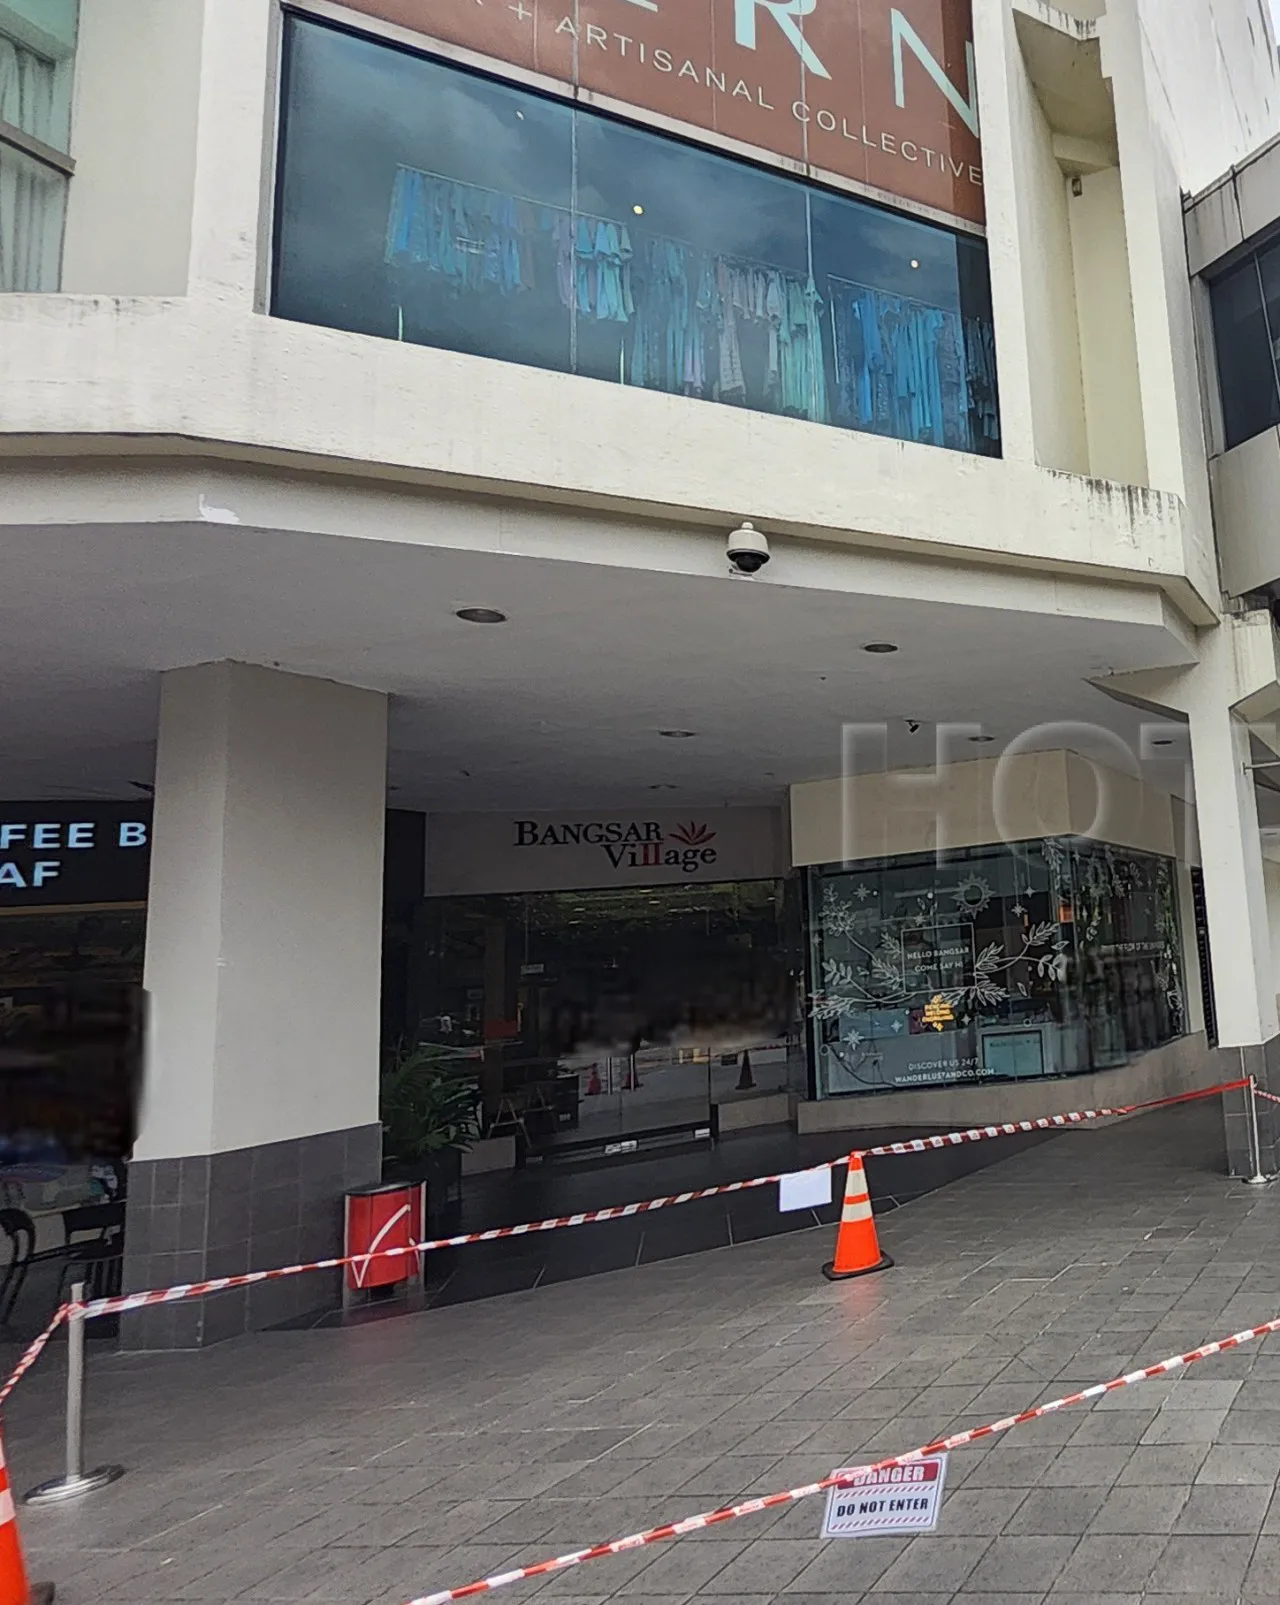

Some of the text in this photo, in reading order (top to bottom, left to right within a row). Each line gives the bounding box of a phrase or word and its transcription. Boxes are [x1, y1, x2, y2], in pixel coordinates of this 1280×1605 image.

[555, 15, 775, 111] ARTISANAL
[791, 100, 982, 186] COLLECTIVE
[0, 822, 147, 849] FEE B
[513, 820, 664, 847] BANGSAR
[0, 861, 61, 888] AF
[907, 950, 932, 960] HELLO
[914, 962, 938, 972] COME
[940, 961, 953, 970] SAY
[908, 1057, 980, 1071] DISCOVER US 24/7
[894, 1067, 995, 1083] WANDERLUSTANDCO.COM
[837, 1497, 929, 1518] DO NOT ENTER
